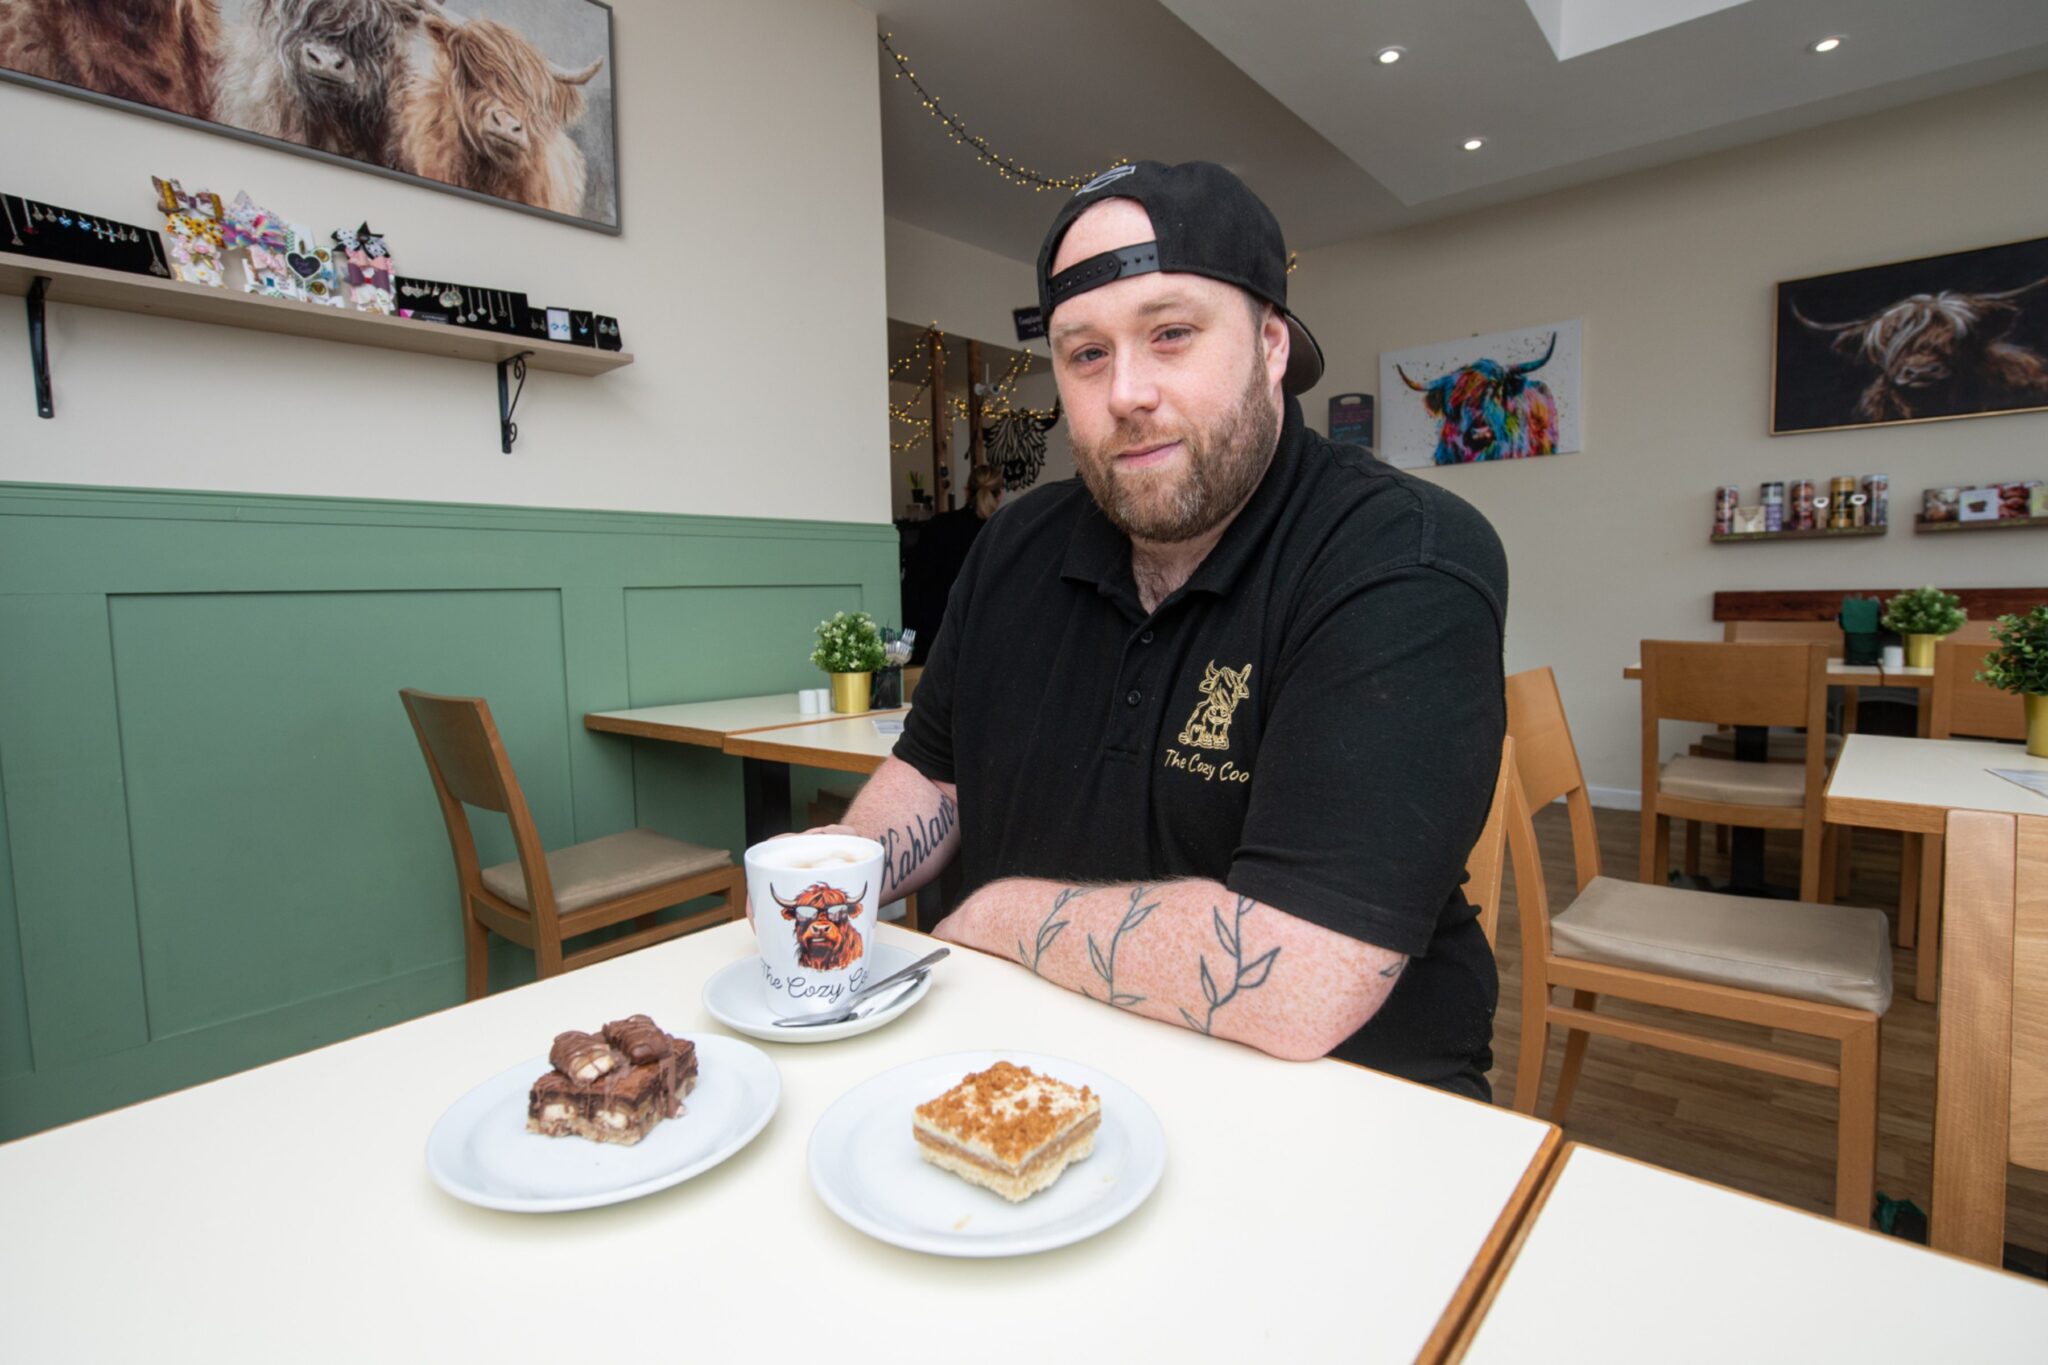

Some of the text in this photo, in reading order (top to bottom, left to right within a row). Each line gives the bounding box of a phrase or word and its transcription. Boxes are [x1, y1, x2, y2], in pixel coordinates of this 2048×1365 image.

[1164, 748, 1250, 783] The Cozy Coo
[760, 957, 783, 989] The
[787, 976, 845, 1004] Cozy
